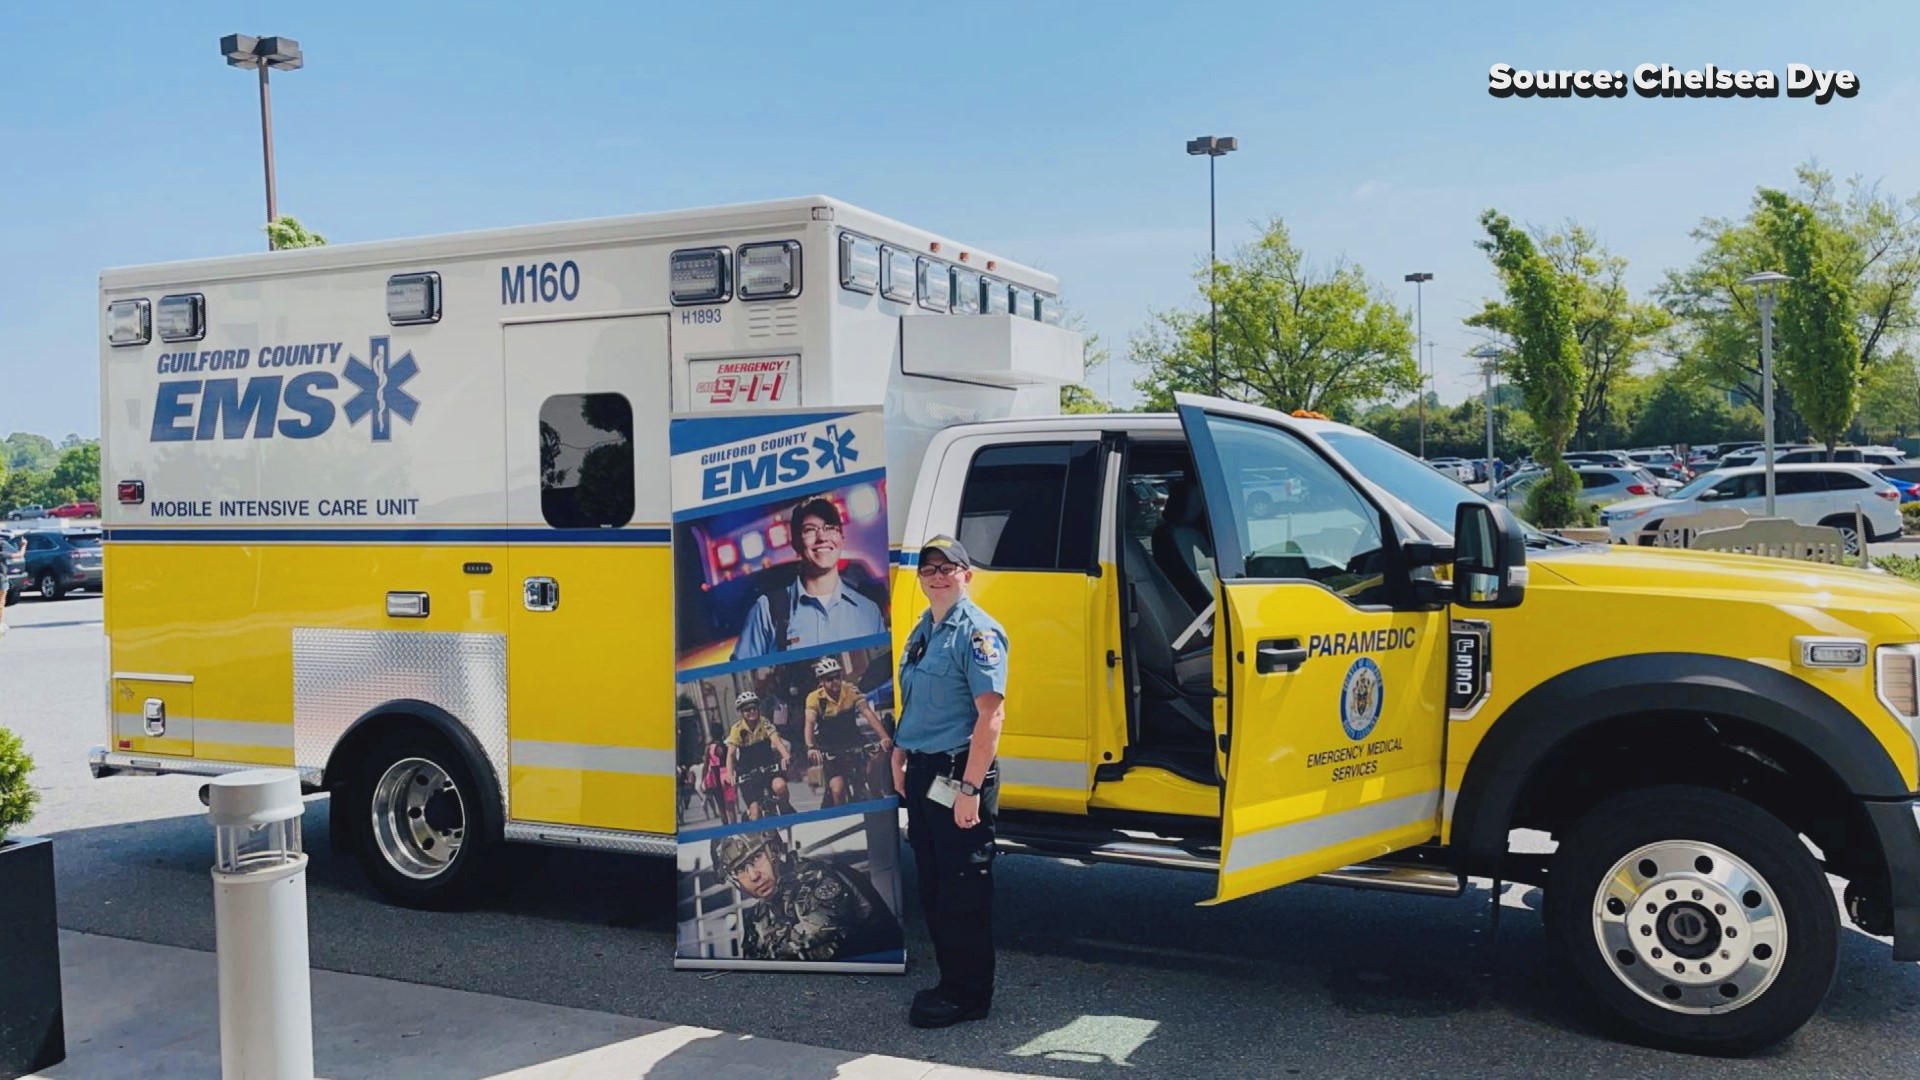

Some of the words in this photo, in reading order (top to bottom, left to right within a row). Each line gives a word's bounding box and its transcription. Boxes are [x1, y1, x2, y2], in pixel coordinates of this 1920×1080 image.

[501, 260, 580, 305] M160
[682, 308, 722, 325] H1893
[157, 349, 250, 374] GUILFORD
[257, 342, 343, 368] COUNTY
[150, 371, 339, 442] EMS
[701, 444, 756, 465] GUILFORD
[761, 432, 807, 452] COUNTY
[702, 446, 810, 501] EMS
[151, 501, 212, 517] MOBILE
[220, 500, 310, 516] INTENSIVE
[318, 499, 368, 515] CARE
[376, 499, 419, 515] UNIT
[1308, 626, 1416, 659] PARAMEDIC
[1307, 745, 1364, 768] EMERGENCY
[1367, 738, 1403, 757] MEDICAL
[1332, 760, 1378, 782] SERVICES
